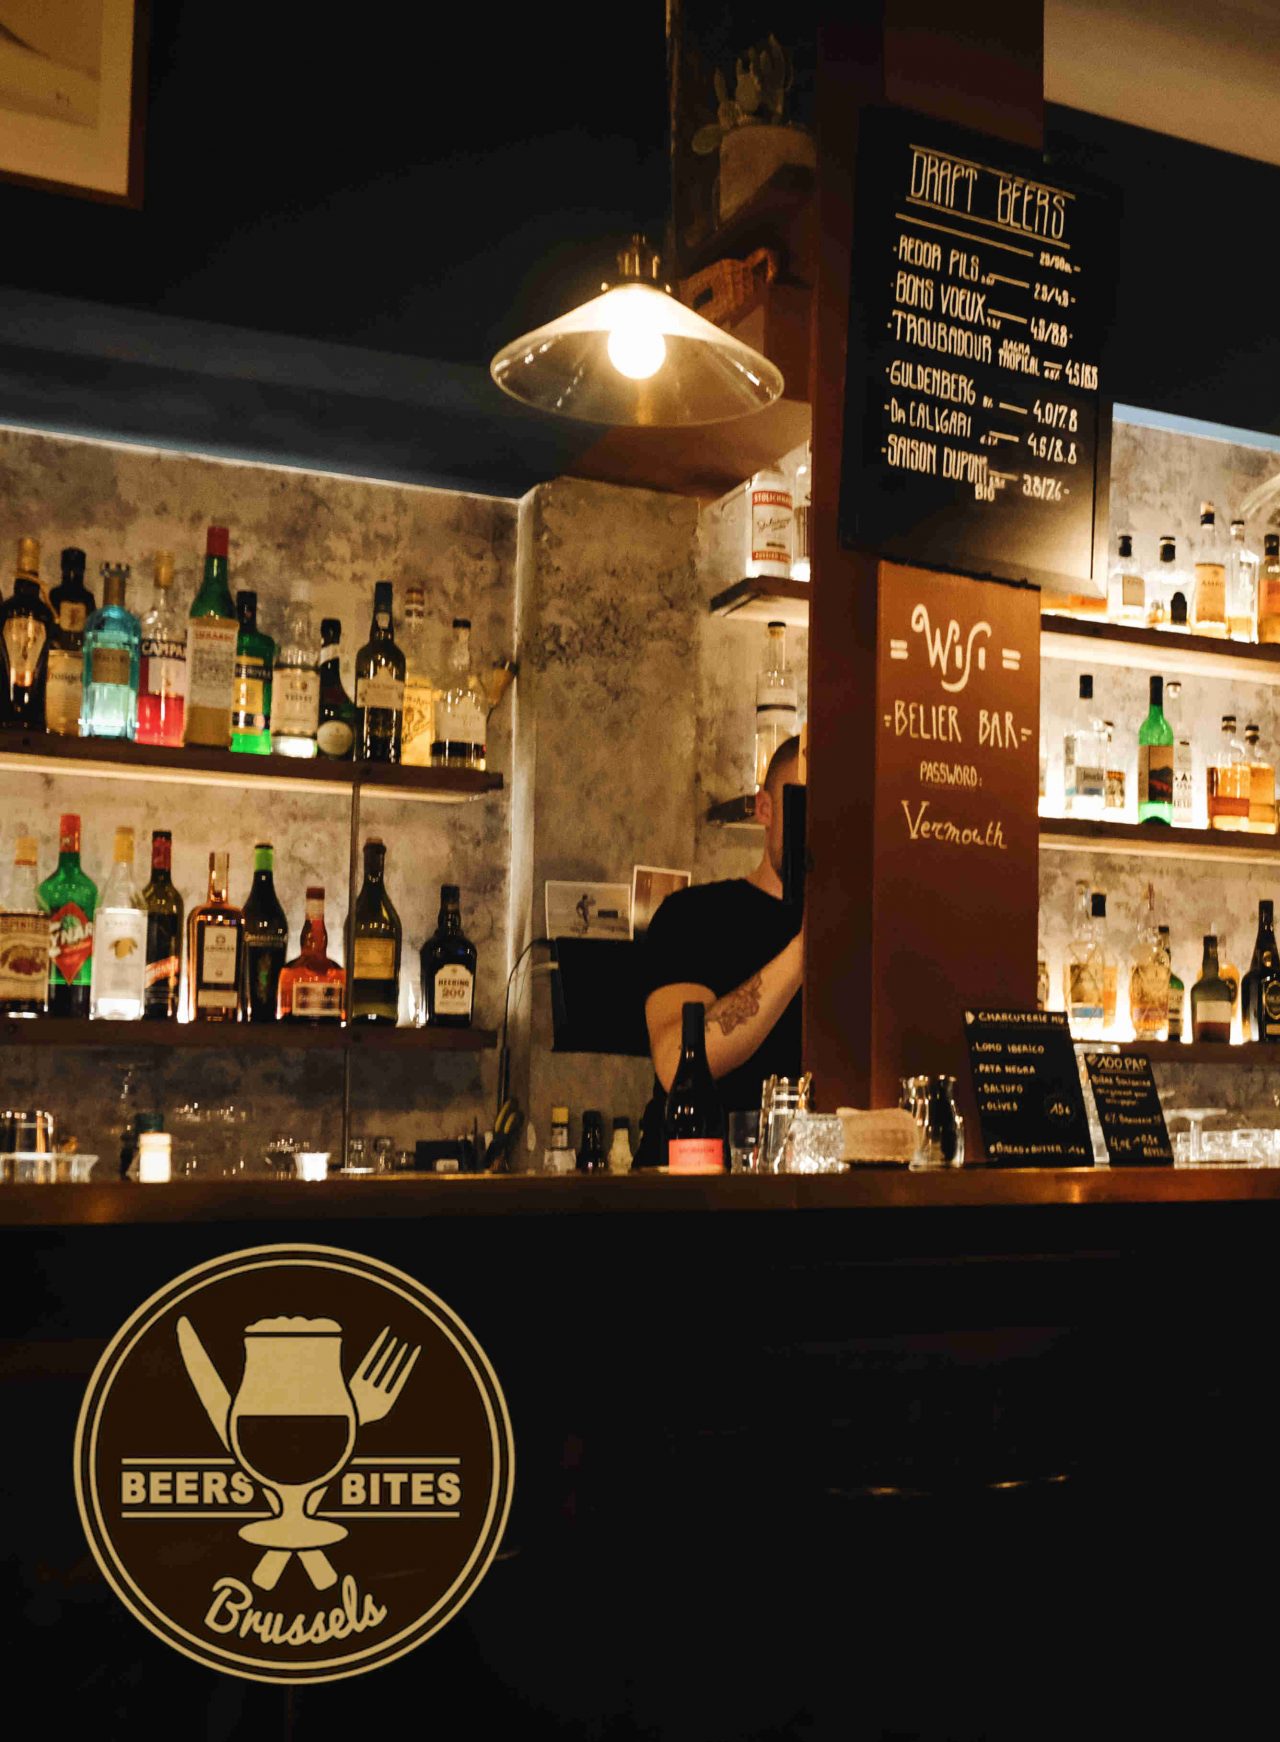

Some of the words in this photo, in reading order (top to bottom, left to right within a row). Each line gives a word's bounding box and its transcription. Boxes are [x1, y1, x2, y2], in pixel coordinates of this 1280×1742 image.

[910, 151, 978, 213] DRAFT
[997, 177, 1066, 240] BEERS
[898, 234, 941, 272] REDOR
[949, 249, 979, 283] PILS
[896, 270, 934, 311] BONS
[940, 283, 987, 326] VOEUX
[892, 309, 992, 364] TROUBADOUR
[889, 360, 977, 406] GULDENBERG
[909, 400, 972, 438] CALIGARI
[888, 433, 937, 475] SAISON
[942, 446, 988, 486] DUPONT
[894, 699, 962, 743] BELIER
[978, 709, 1018, 749] BAR
[978, 1063, 1002, 1074] PATA
[1005, 1064, 1036, 1074] NEGRA
